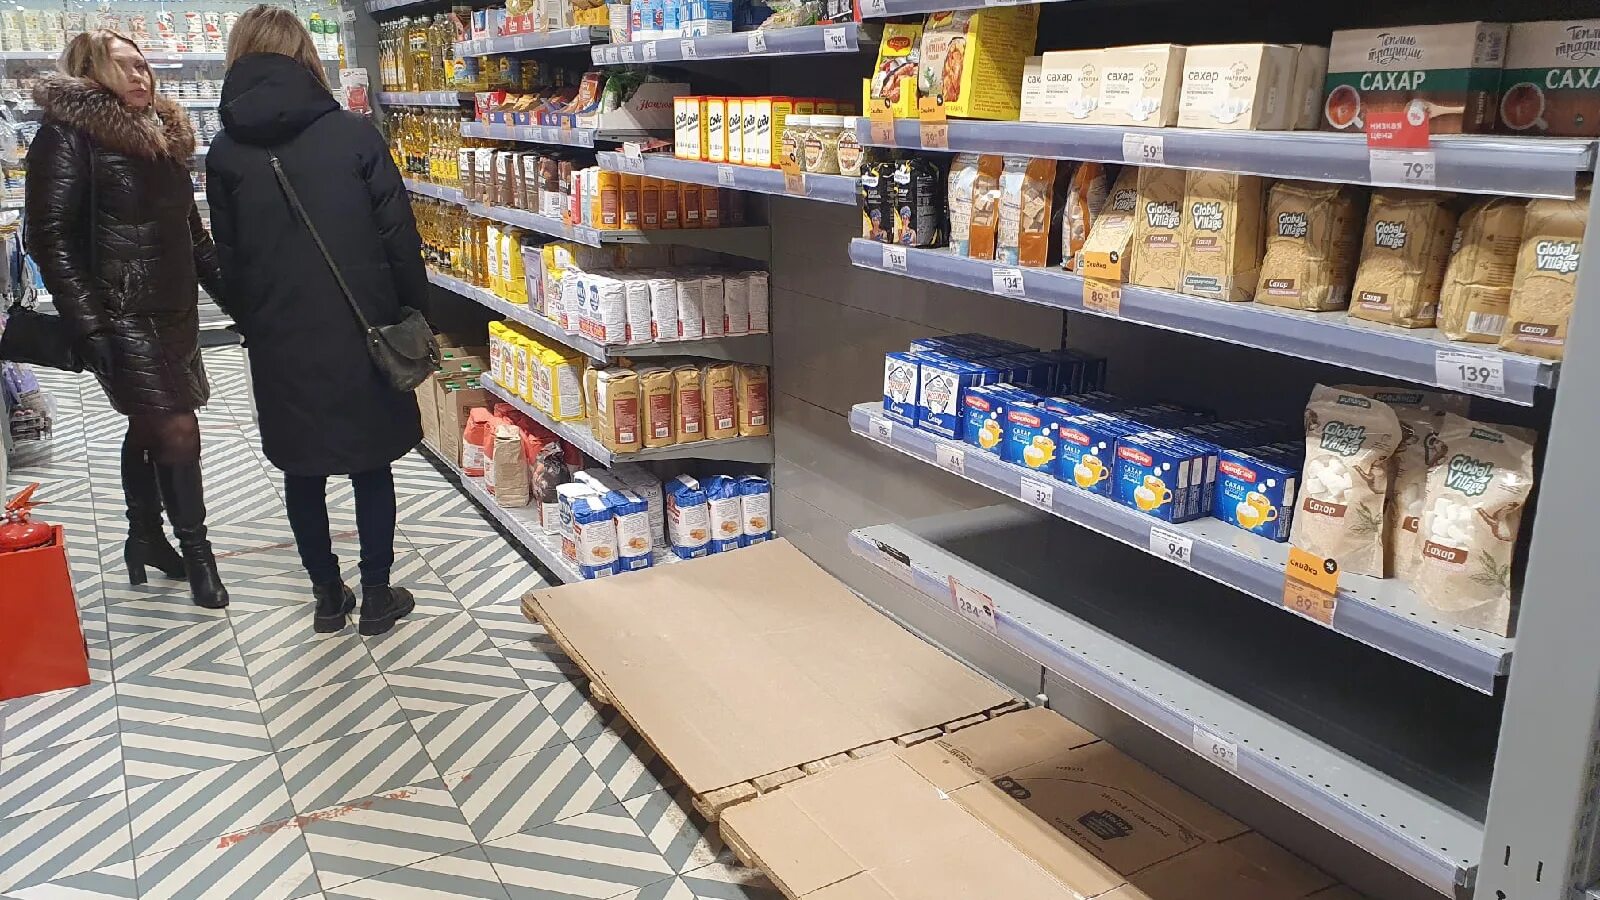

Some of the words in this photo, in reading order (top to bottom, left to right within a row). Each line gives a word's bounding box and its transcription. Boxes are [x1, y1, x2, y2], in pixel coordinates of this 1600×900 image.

[1046, 73, 1073, 84] сахар
[1107, 70, 1134, 83] сахар
[1188, 70, 1219, 83] сахар
[1360, 71, 1426, 91] САХАР
[1369, 122, 1402, 131] низкая
[1369, 131, 1393, 141] цена
[1142, 144, 1156, 158] 59
[1402, 161, 1424, 179] 79
[1146, 202, 1177, 216] Global
[1192, 203, 1222, 217] Global
[1148, 212, 1180, 228] Village
[1194, 215, 1223, 230] Village
[1278, 213, 1306, 225] Global
[1278, 223, 1307, 237] Village
[1375, 221, 1404, 234] Global
[1375, 233, 1405, 248] Village
[1536, 241, 1577, 256] Global
[1537, 255, 1578, 272] Village
[1091, 290, 1104, 302] 89
[1362, 292, 1382, 303] Сахар
[1519, 324, 1549, 336] Сахар
[1458, 364, 1491, 383] 139
[1325, 422, 1364, 440] Global
[1321, 437, 1359, 456] Village
[1450, 457, 1491, 478] Global
[1224, 480, 1245, 492] САХАР
[1446, 472, 1485, 496] Village
[1036, 489, 1046, 503] 32
[1309, 500, 1335, 515] Сахар
[1168, 542, 1184, 559] 94
[1426, 543, 1456, 560] Сахар
[1295, 596, 1313, 611] 89
[1212, 743, 1226, 758] 69
